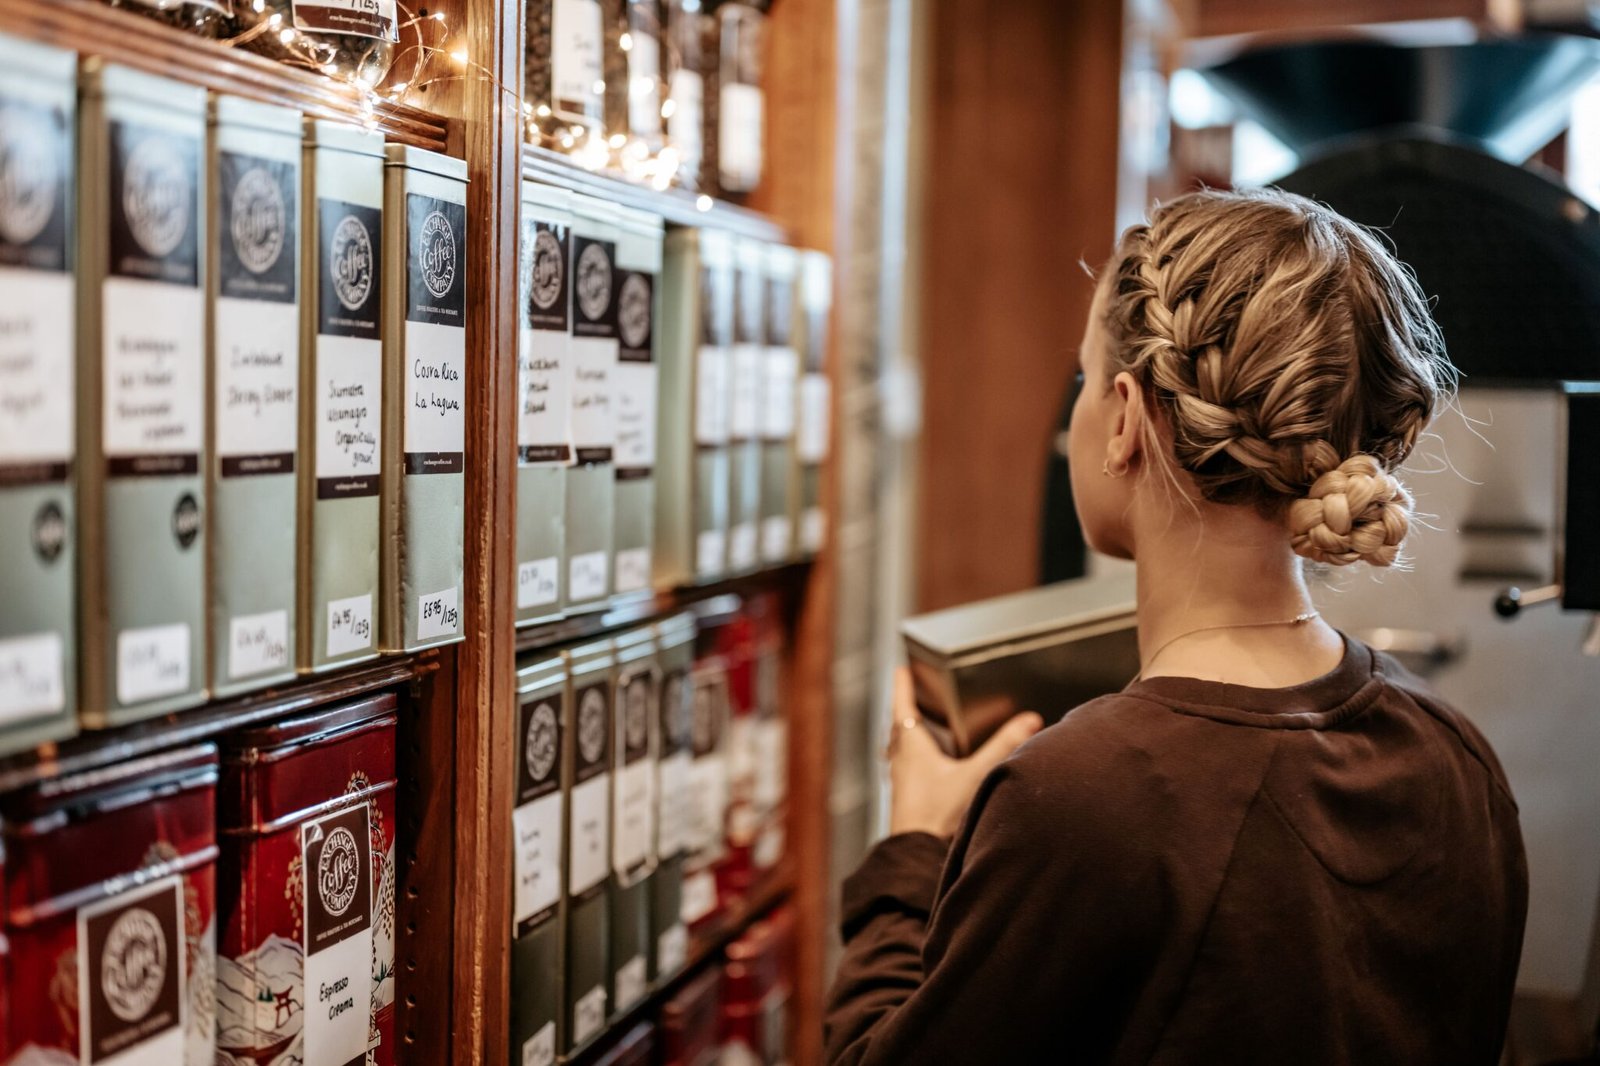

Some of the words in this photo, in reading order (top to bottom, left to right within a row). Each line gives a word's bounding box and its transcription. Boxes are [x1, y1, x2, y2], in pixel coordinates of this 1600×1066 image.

[422, 215, 452, 246] EXCHANGE
[423, 238, 453, 273] Coffee
[426, 261, 453, 292] COMPANY
[415, 358, 440, 379] Costa
[441, 362, 459, 381] Rica
[416, 391, 427, 409] La
[431, 391, 460, 417] Laguna
[321, 832, 353, 871] EXCHANGE
[322, 851, 355, 895] Coffee
[326, 870, 356, 910] COMPANY
[320, 976, 349, 1002] Espresso
